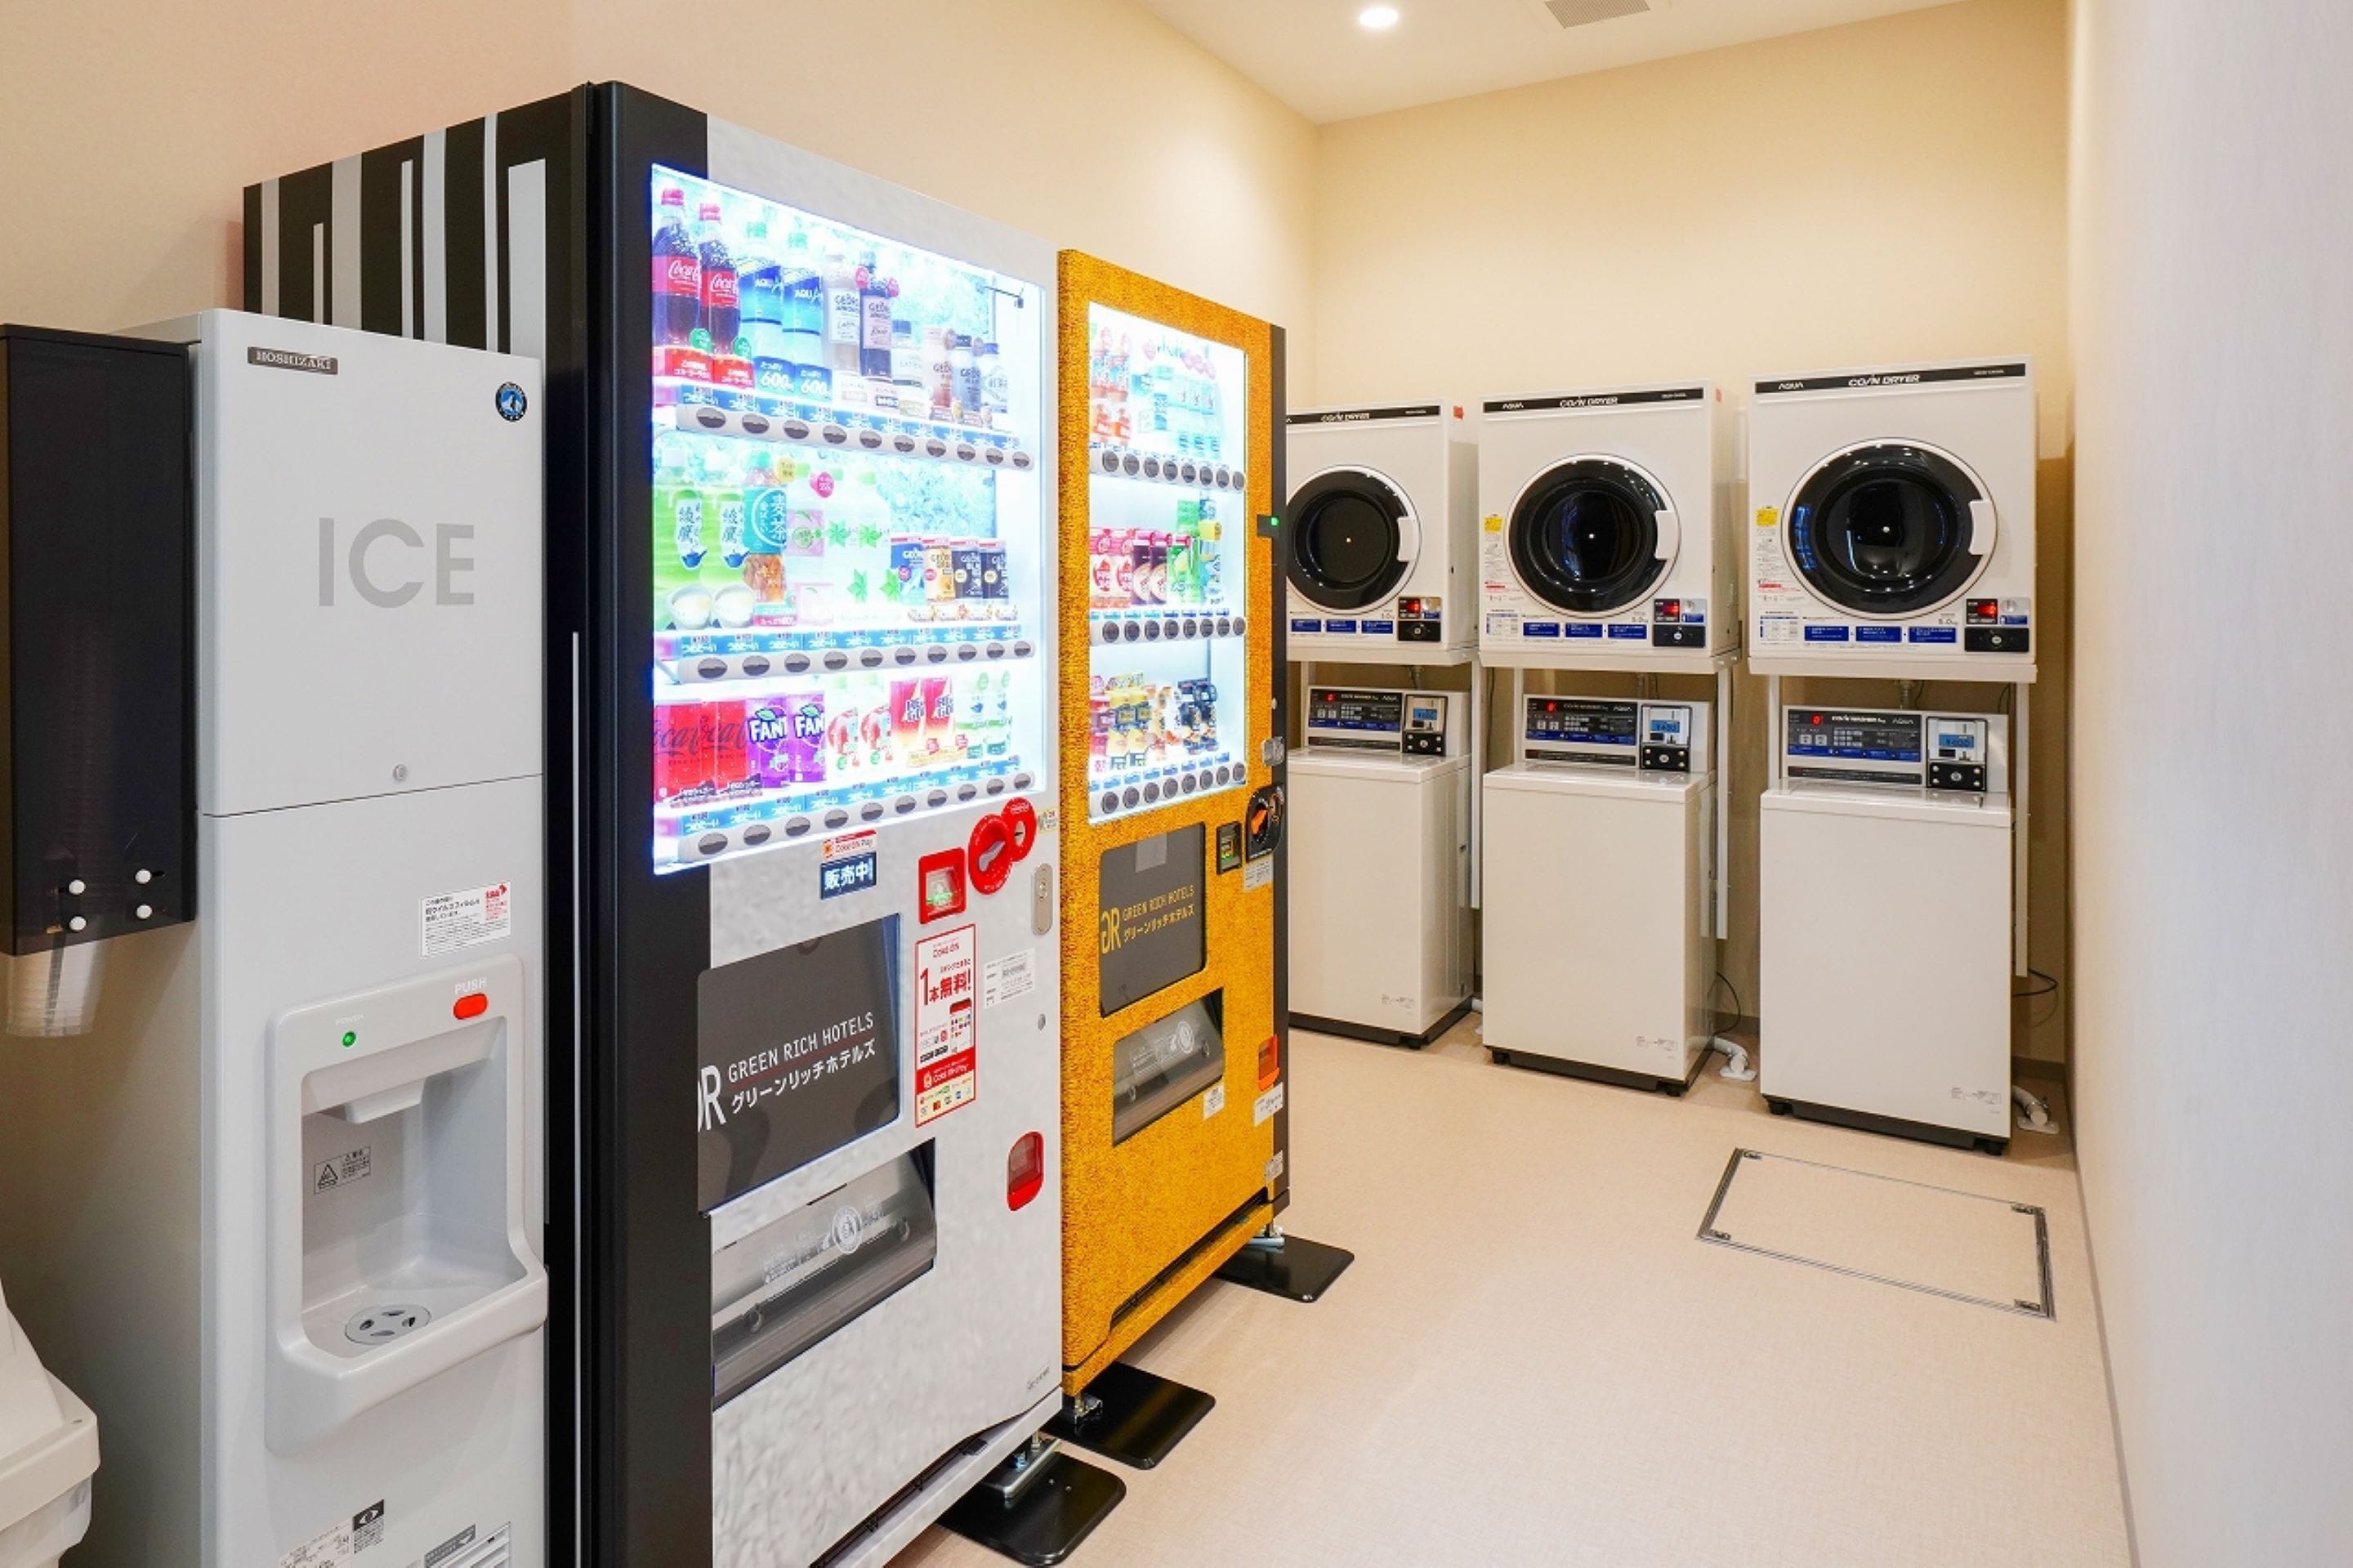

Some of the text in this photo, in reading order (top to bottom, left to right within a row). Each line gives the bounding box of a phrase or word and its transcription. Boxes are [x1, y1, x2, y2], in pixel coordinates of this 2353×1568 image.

[256, 350, 332, 371] HOSHIZAKI
[1778, 380, 1804, 391] AQUA
[1882, 373, 1920, 385] DRYER
[318, 517, 475, 609] ICE
[824, 860, 868, 891] 販売中
[1123, 885, 1195, 921] GREEN RICH HOTELS
[1123, 905, 1195, 943] グリーンリッチホテルズ
[453, 976, 487, 995] PUSH
[728, 1011, 874, 1083] GREEN RICH HOTELS
[731, 1038, 877, 1115] グリーンリッチホテルズ
